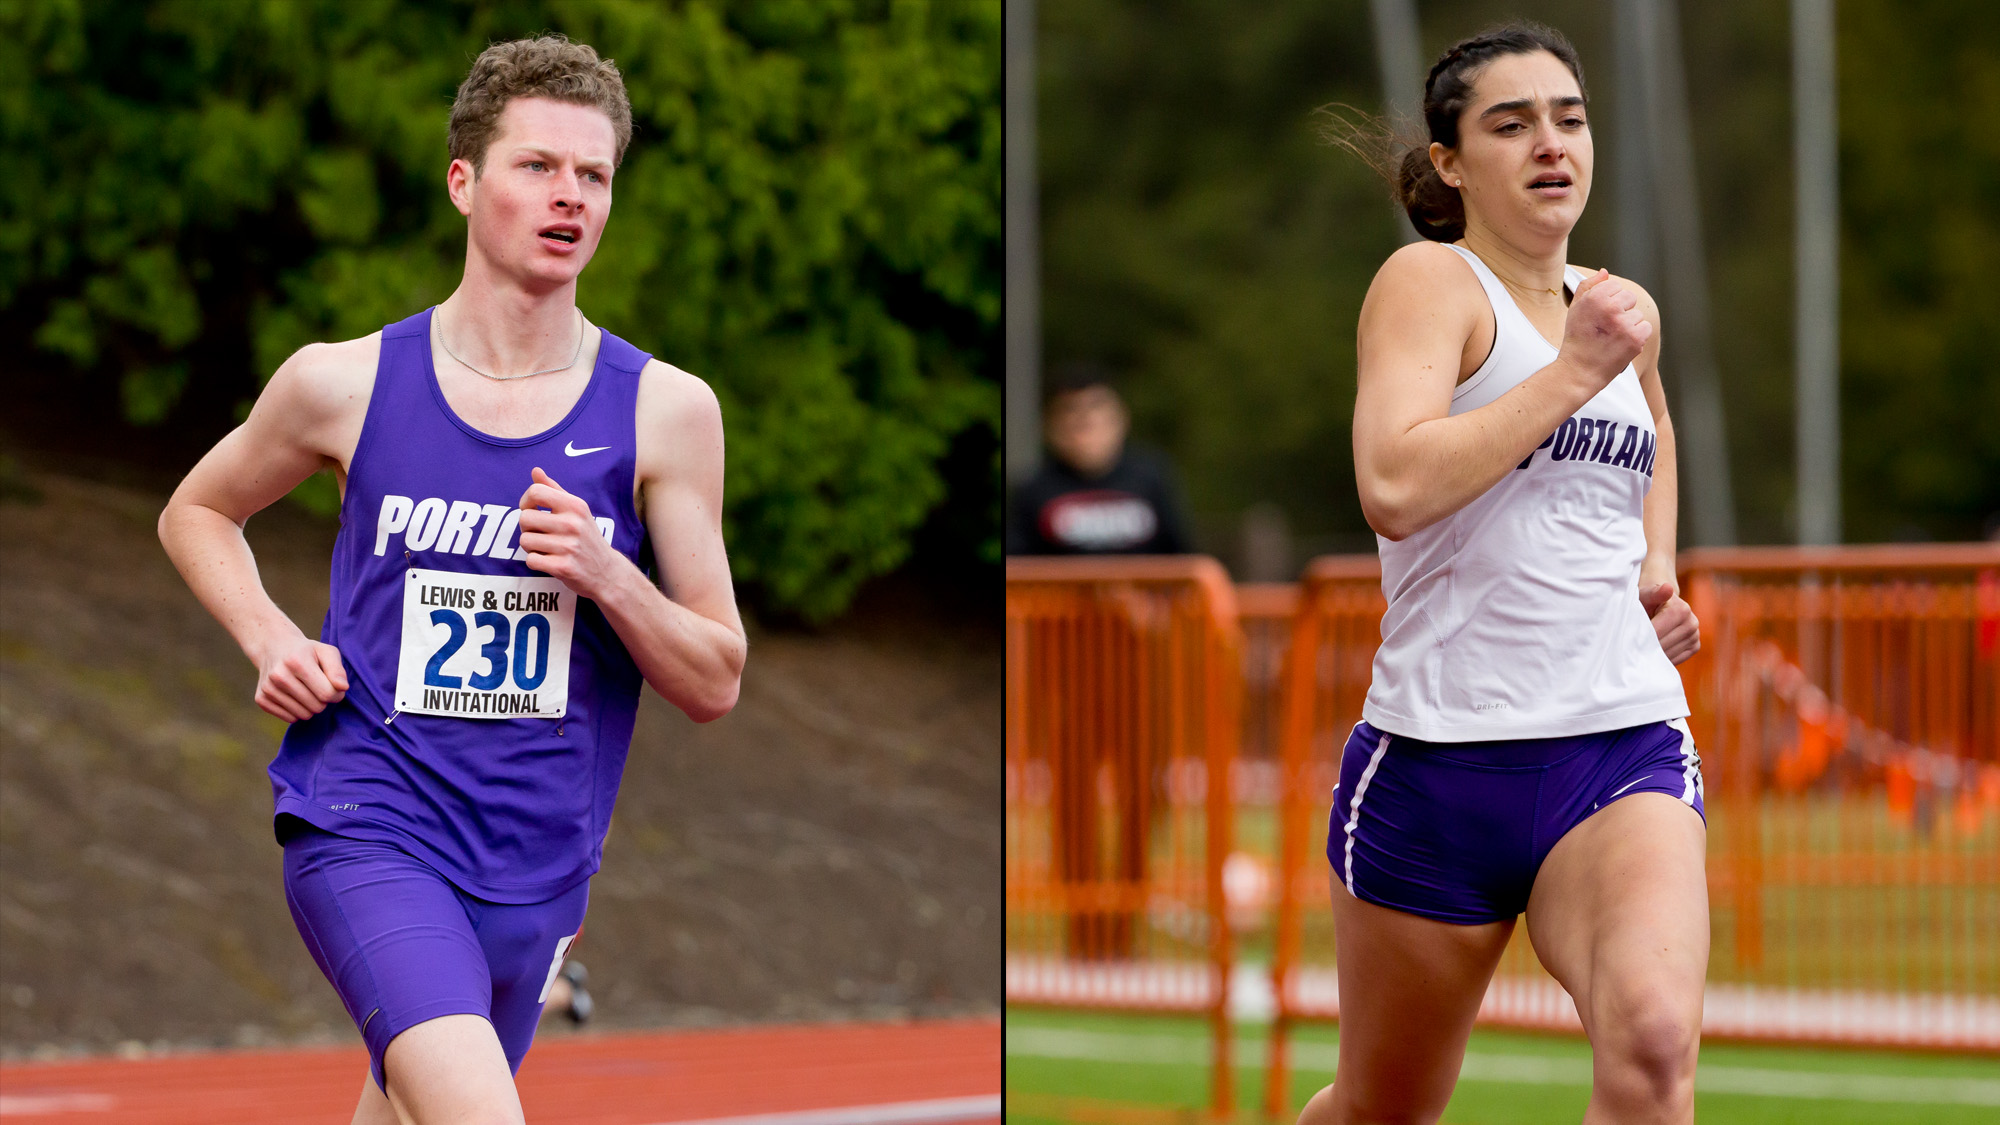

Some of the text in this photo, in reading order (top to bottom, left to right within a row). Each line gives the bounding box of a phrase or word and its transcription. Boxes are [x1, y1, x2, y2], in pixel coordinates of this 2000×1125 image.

[1516, 416, 1656, 478] ORTLAN
[373, 494, 615, 562] PORTL
[420, 585, 560, 612] LEWIS & CLARK
[423, 608, 550, 691] 230
[423, 688, 540, 713] INVITATIONAL
[1476, 703, 1508, 711] DRI-FIT
[328, 803, 360, 811] I-FIT
